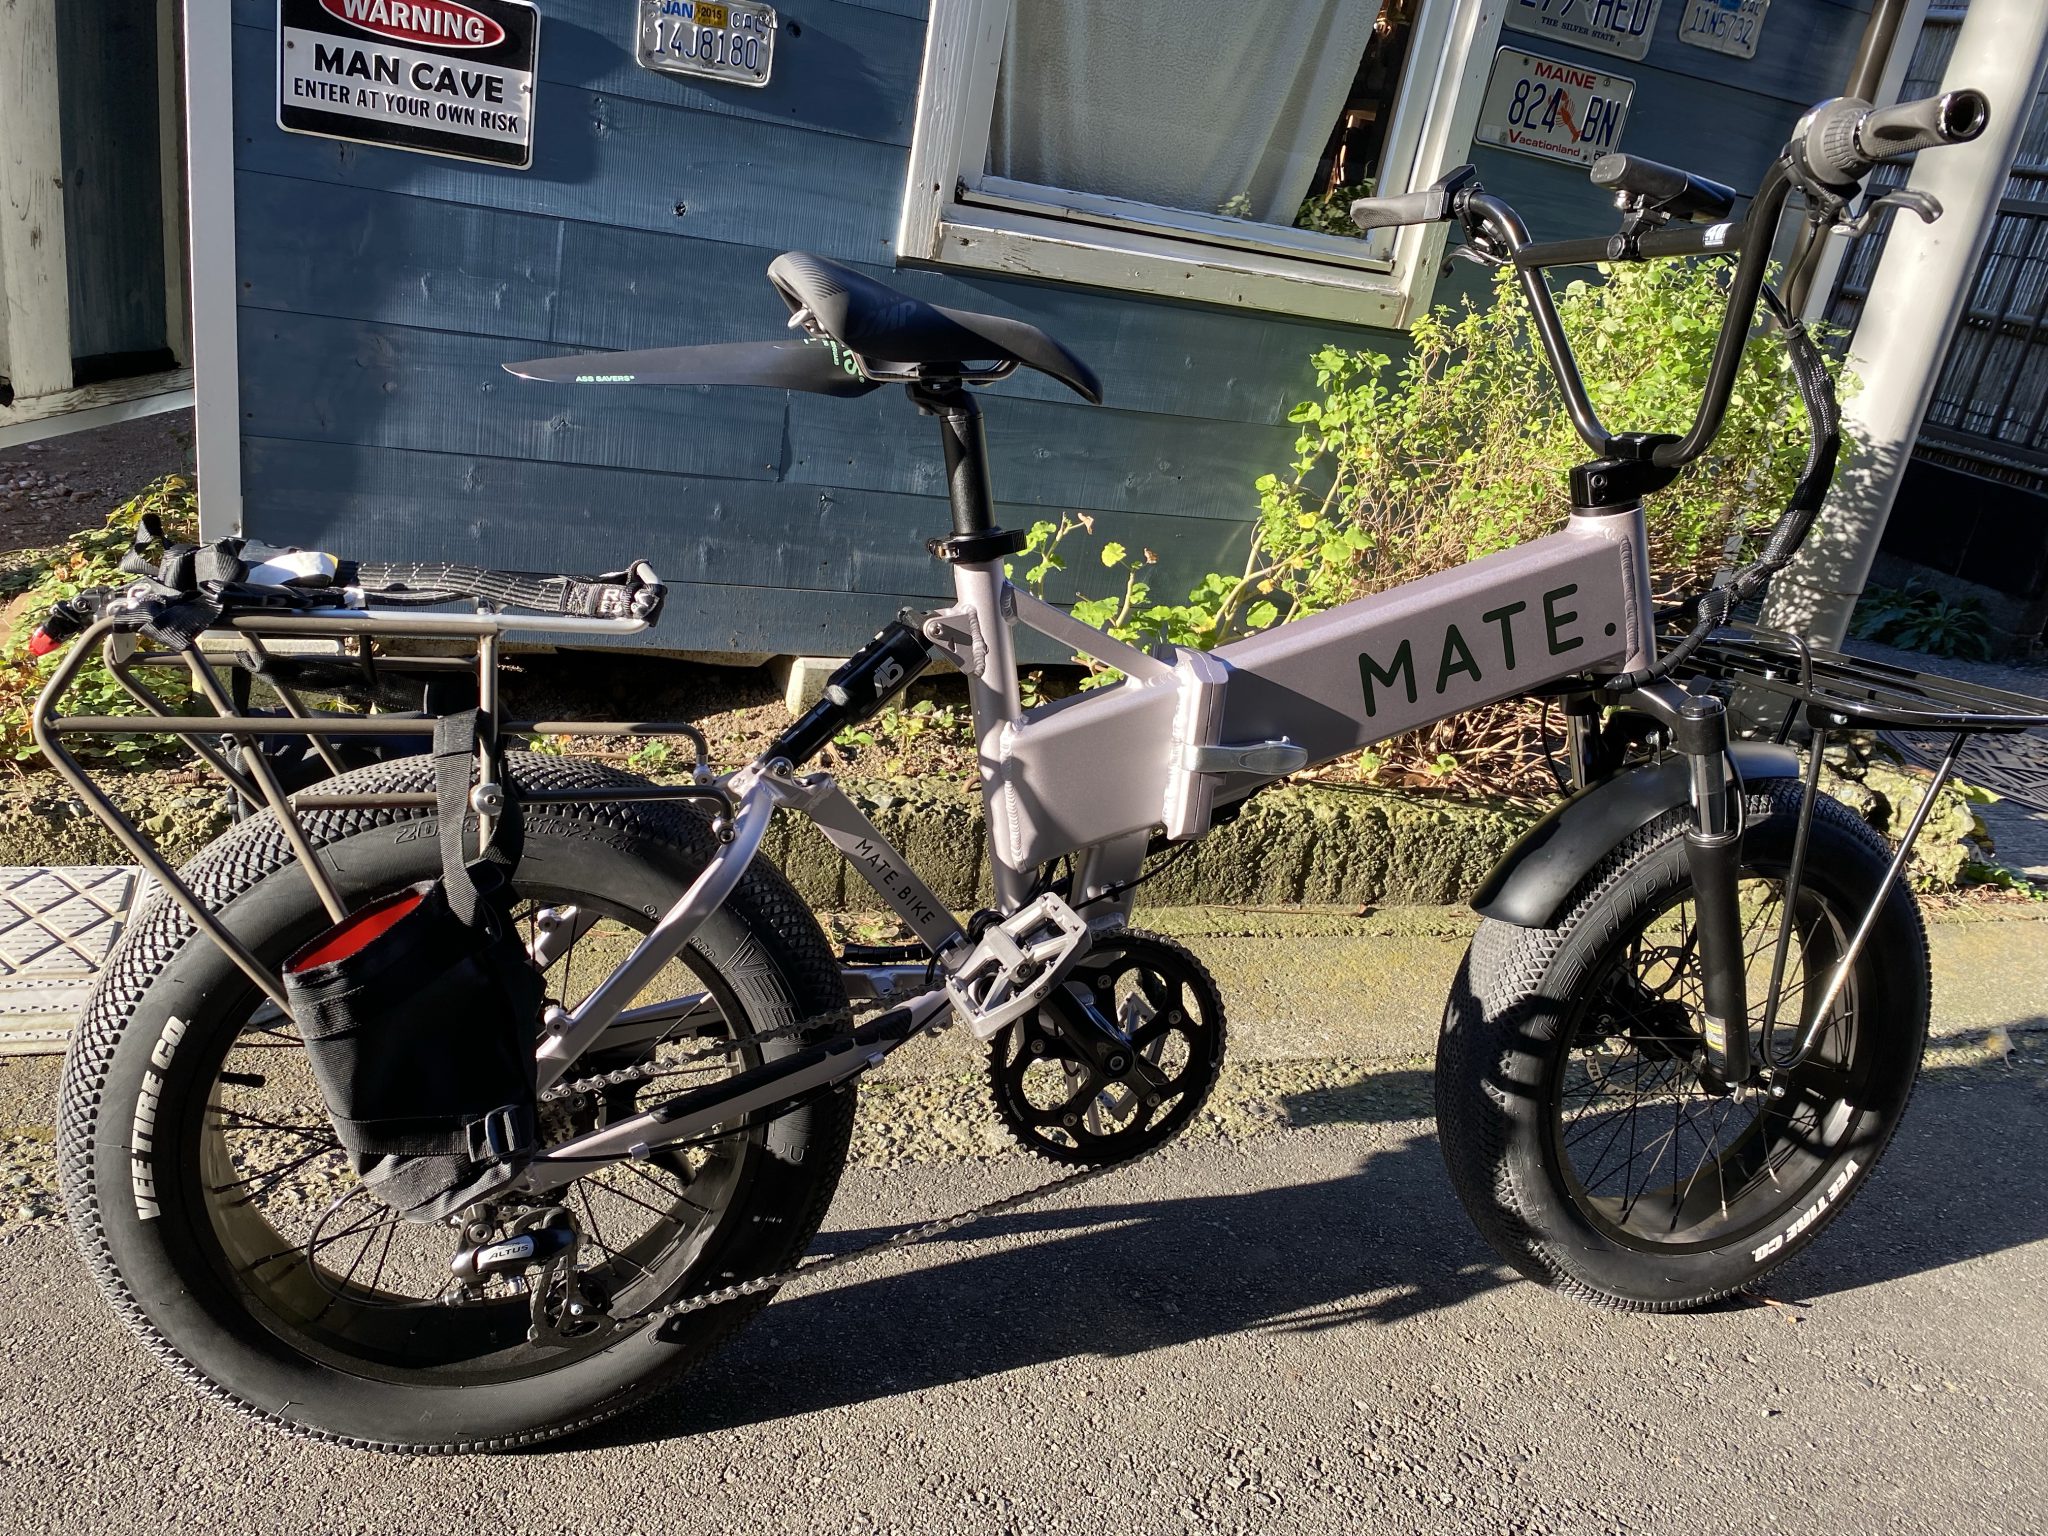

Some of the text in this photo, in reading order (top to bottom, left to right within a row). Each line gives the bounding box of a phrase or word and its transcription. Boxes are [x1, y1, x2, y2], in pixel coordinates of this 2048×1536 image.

[343, 0, 485, 44] WARNING
[662, 0, 693, 18] JAN
[701, 7, 722, 20] 2015
[1541, 16, 1616, 42] THE SILVER STATE
[1689, 6, 1754, 44] 11N5732
[654, 19, 758, 70] 14J8180
[314, 43, 504, 104] MAN CAVE
[1534, 62, 1597, 90] MAINE
[294, 78, 518, 134] ENTER AT YOUR OWN RISK
[1508, 79, 1621, 147] 824 BN
[1509, 128, 1581, 156] Vacationland
[1359, 583, 1617, 717] MATE.
[855, 839, 935, 925] MATE.BIKE
[131, 1015, 191, 1221] VEE TIRE CO.
[1827, 1160, 1859, 1202] VEE
[1786, 1196, 1829, 1243] TIRE
[489, 1244, 529, 1260] ALTUS
